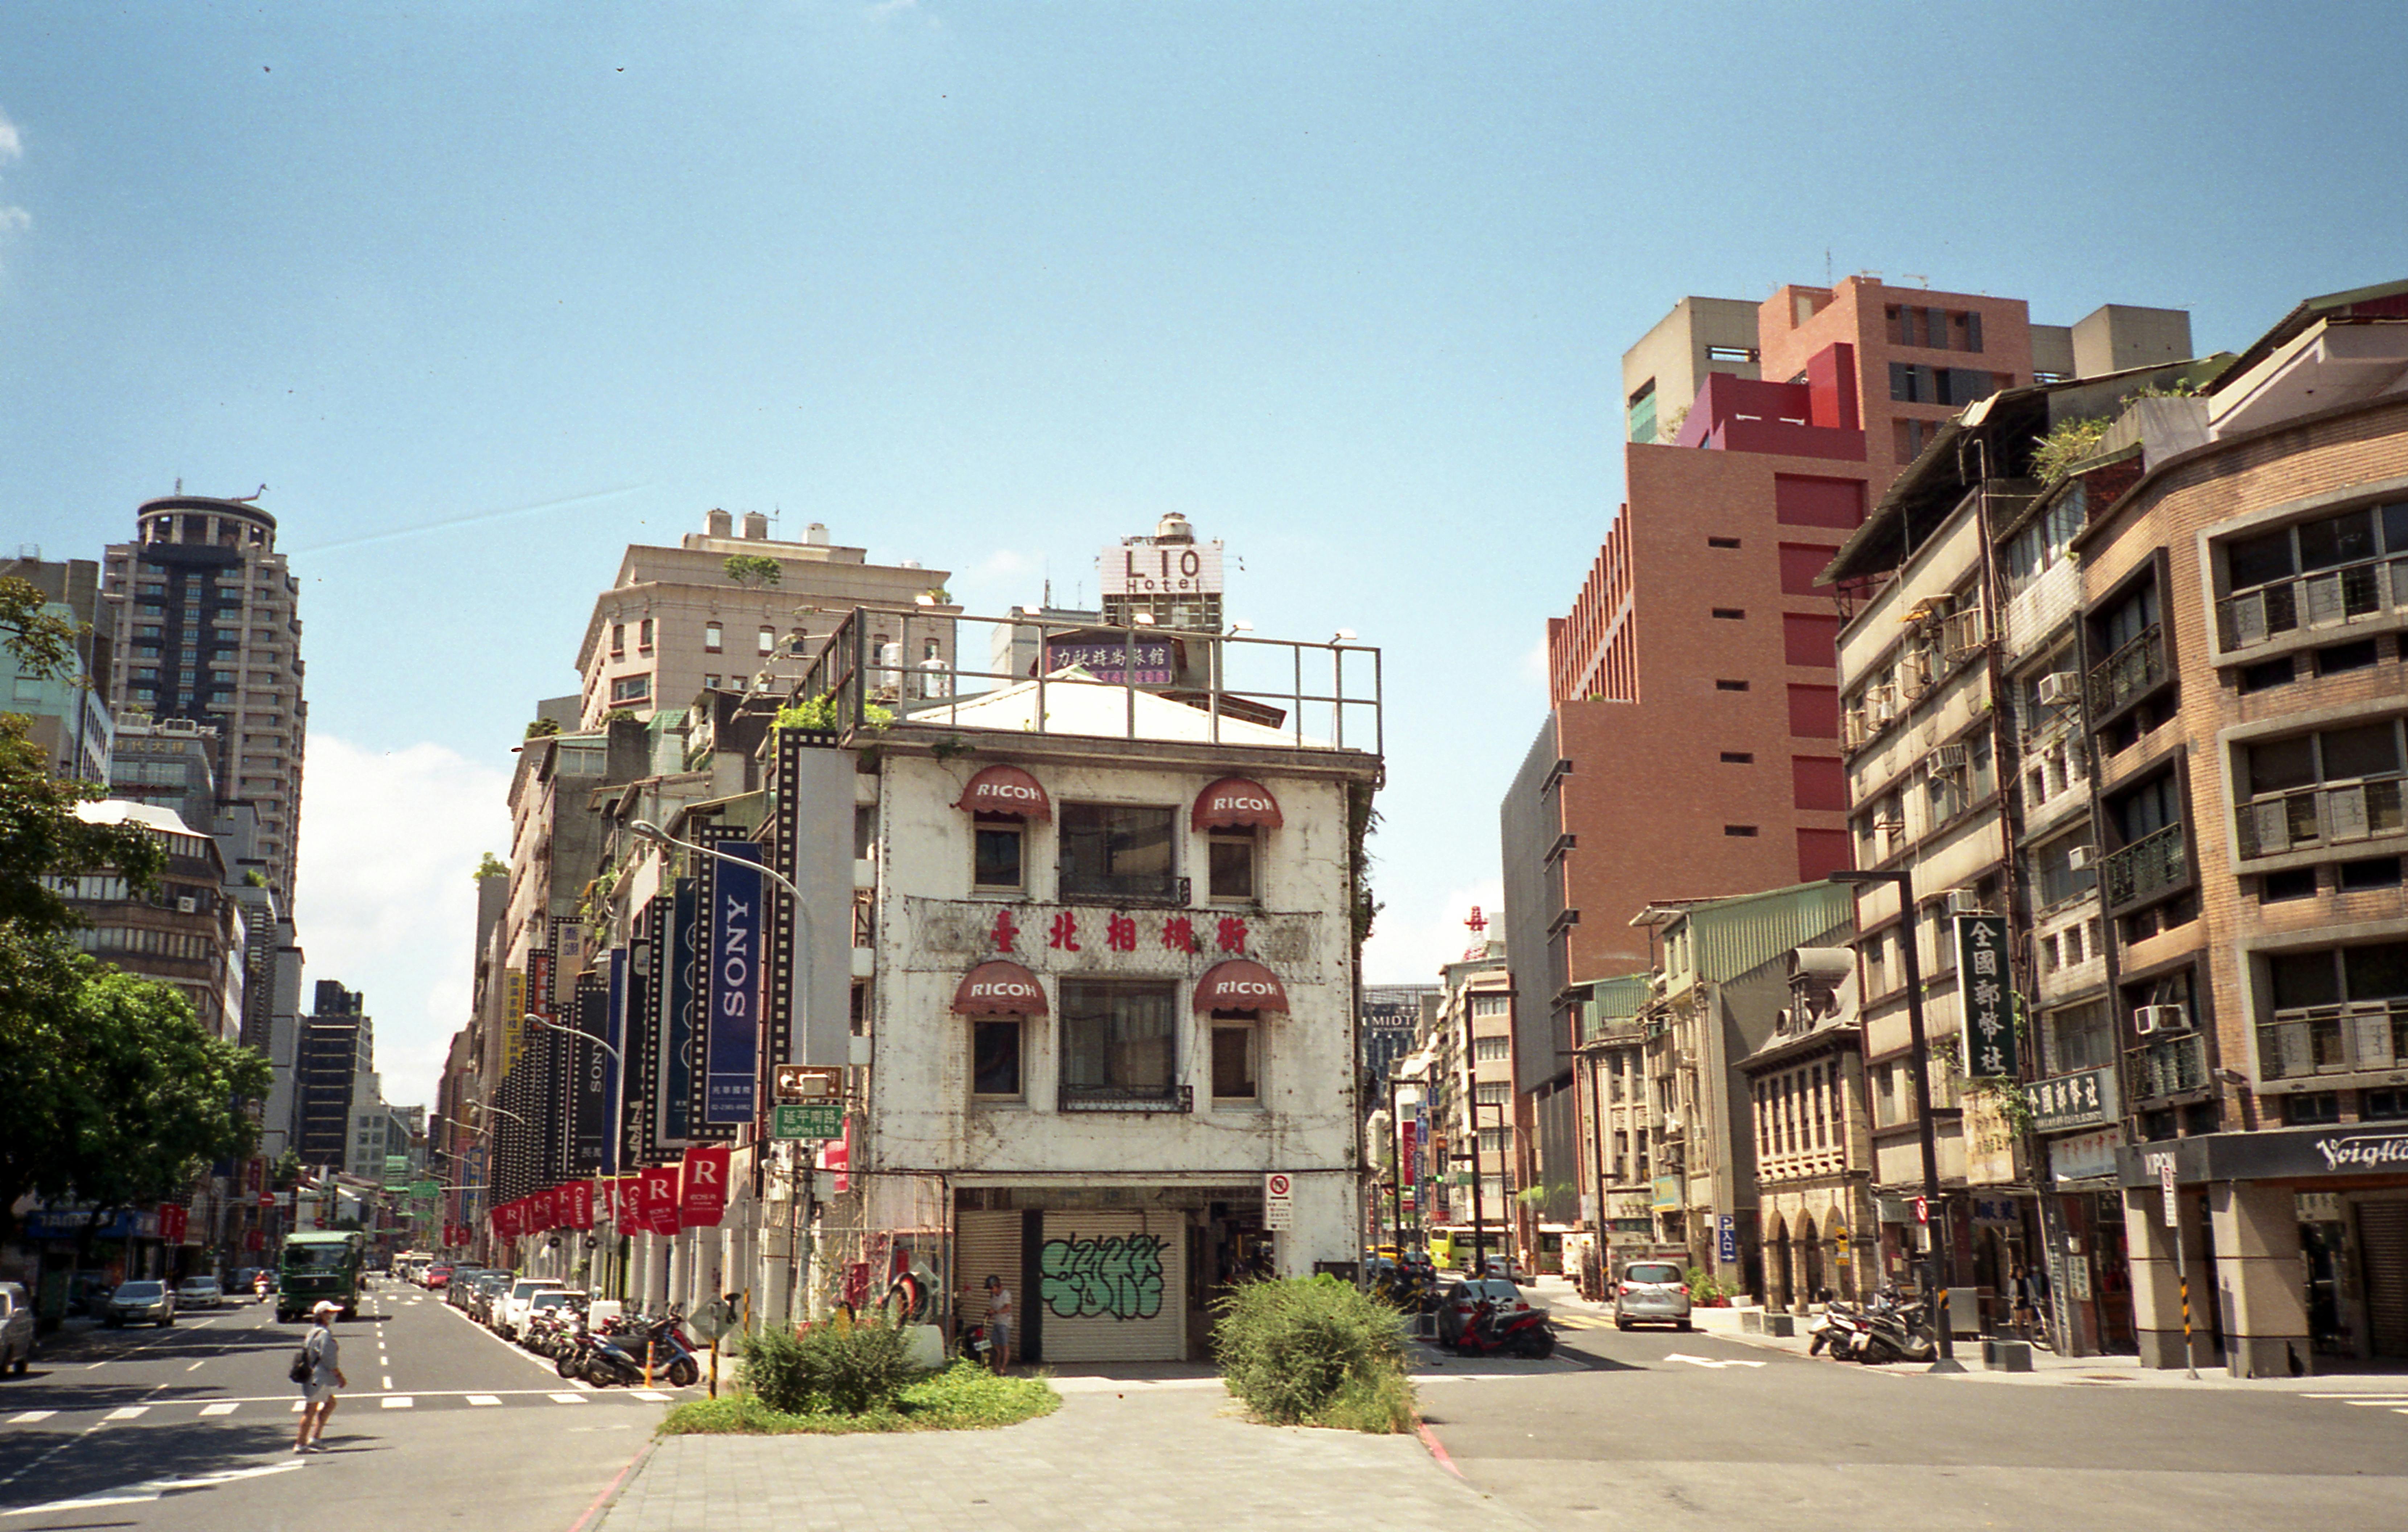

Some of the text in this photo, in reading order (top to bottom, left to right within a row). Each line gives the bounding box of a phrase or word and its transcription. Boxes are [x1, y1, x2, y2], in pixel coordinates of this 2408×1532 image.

[1126, 550, 1200, 577] LIO
[1126, 579, 1199, 593] Hotel
[976, 784, 1041, 802] RICOH
[1214, 797, 1274, 812] RICOH
[990, 910, 1249, 955] 臺北相機街
[723, 894, 748, 1017] SONY
[971, 982, 1037, 998] RICOH
[1216, 980, 1278, 996] RICOH
[1969, 921, 2006, 1073] 全國郵幣社
[1372, 1016, 1417, 1026] MIDT
[784, 1110, 835, 1124] 延平南路
[692, 1161, 718, 1184] R
[649, 1179, 670, 1200] R
[575, 1187, 585, 1224] Canon
[1721, 1217, 1732, 1229] P
[1722, 1231, 1733, 1251] 入口
